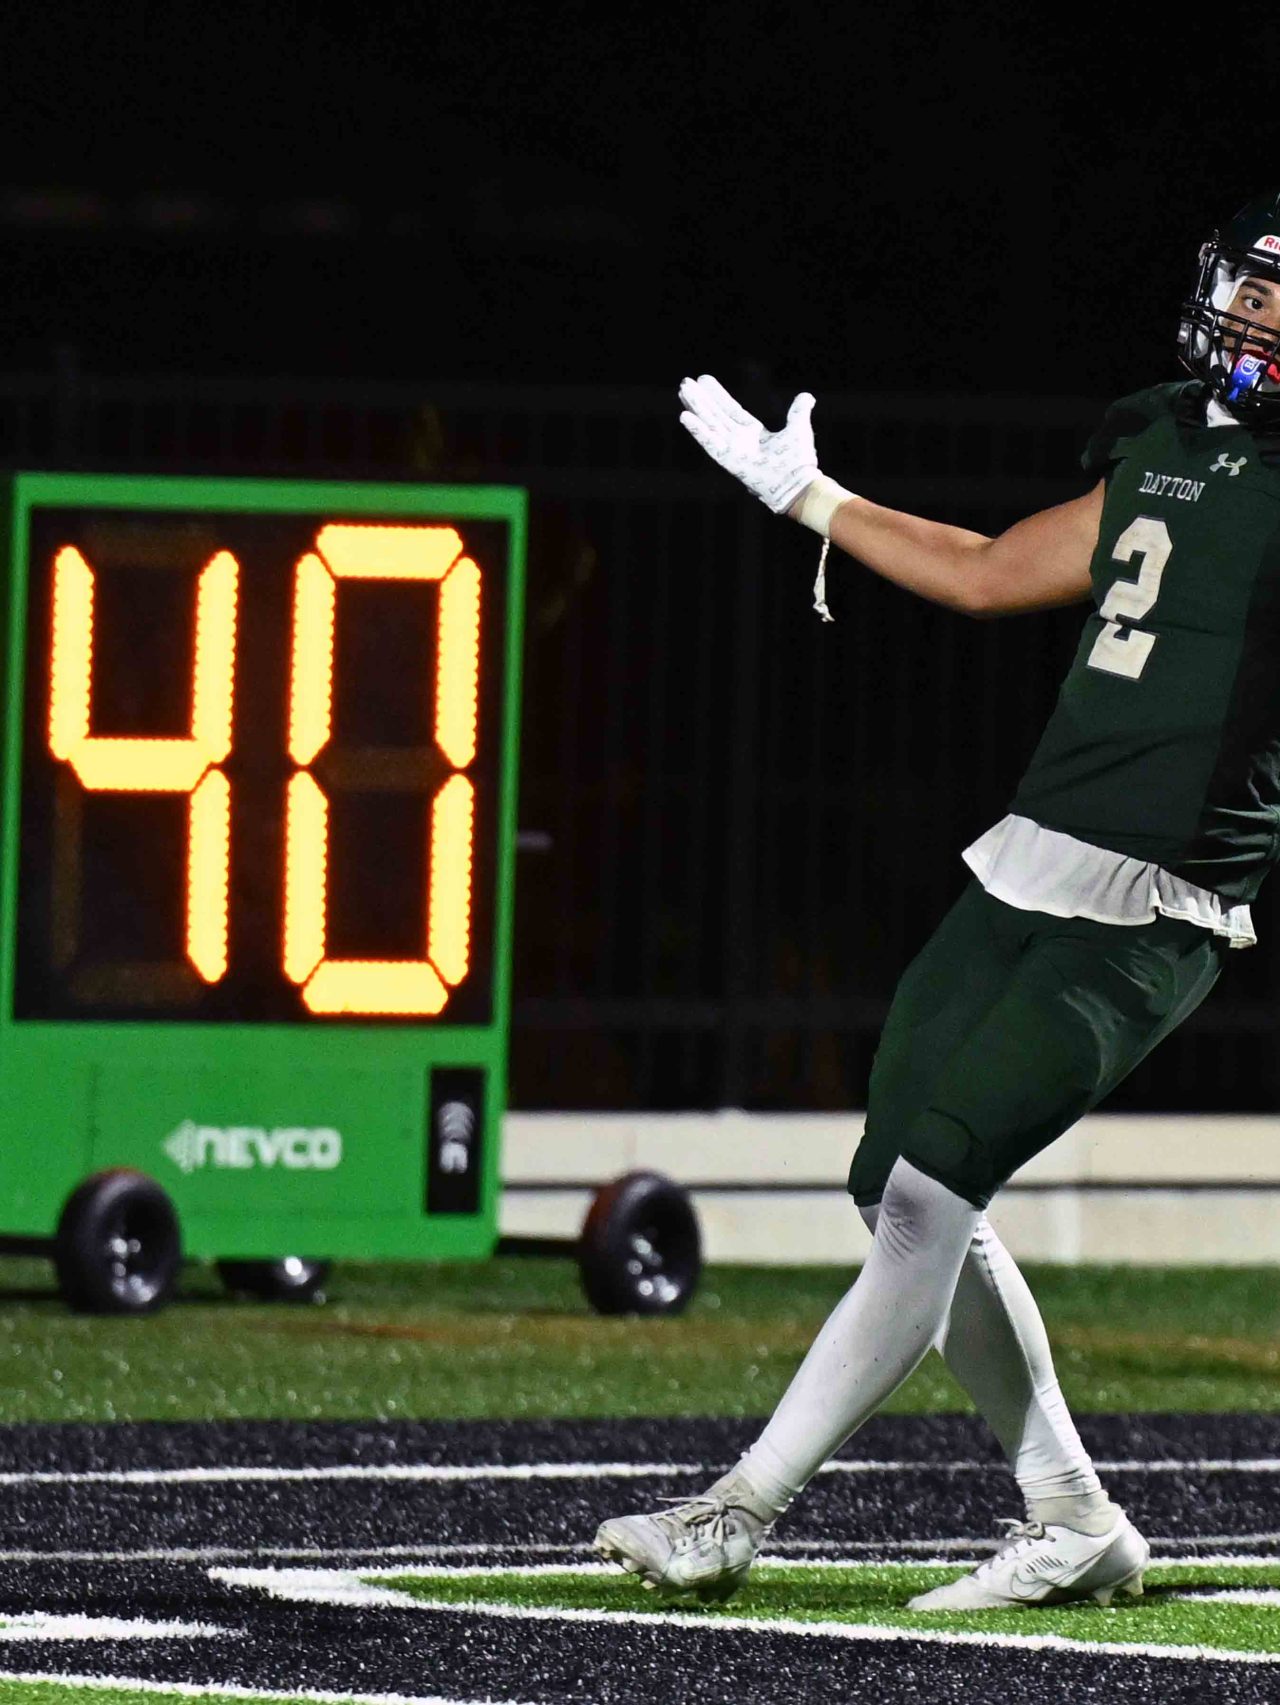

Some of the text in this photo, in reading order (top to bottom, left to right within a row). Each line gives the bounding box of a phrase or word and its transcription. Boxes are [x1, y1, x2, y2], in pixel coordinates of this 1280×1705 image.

[1139, 471, 1206, 502] DAYTON
[1087, 514, 1173, 681] 2
[48, 523, 482, 1015] 40
[199, 1125, 342, 1170] NEVCO
